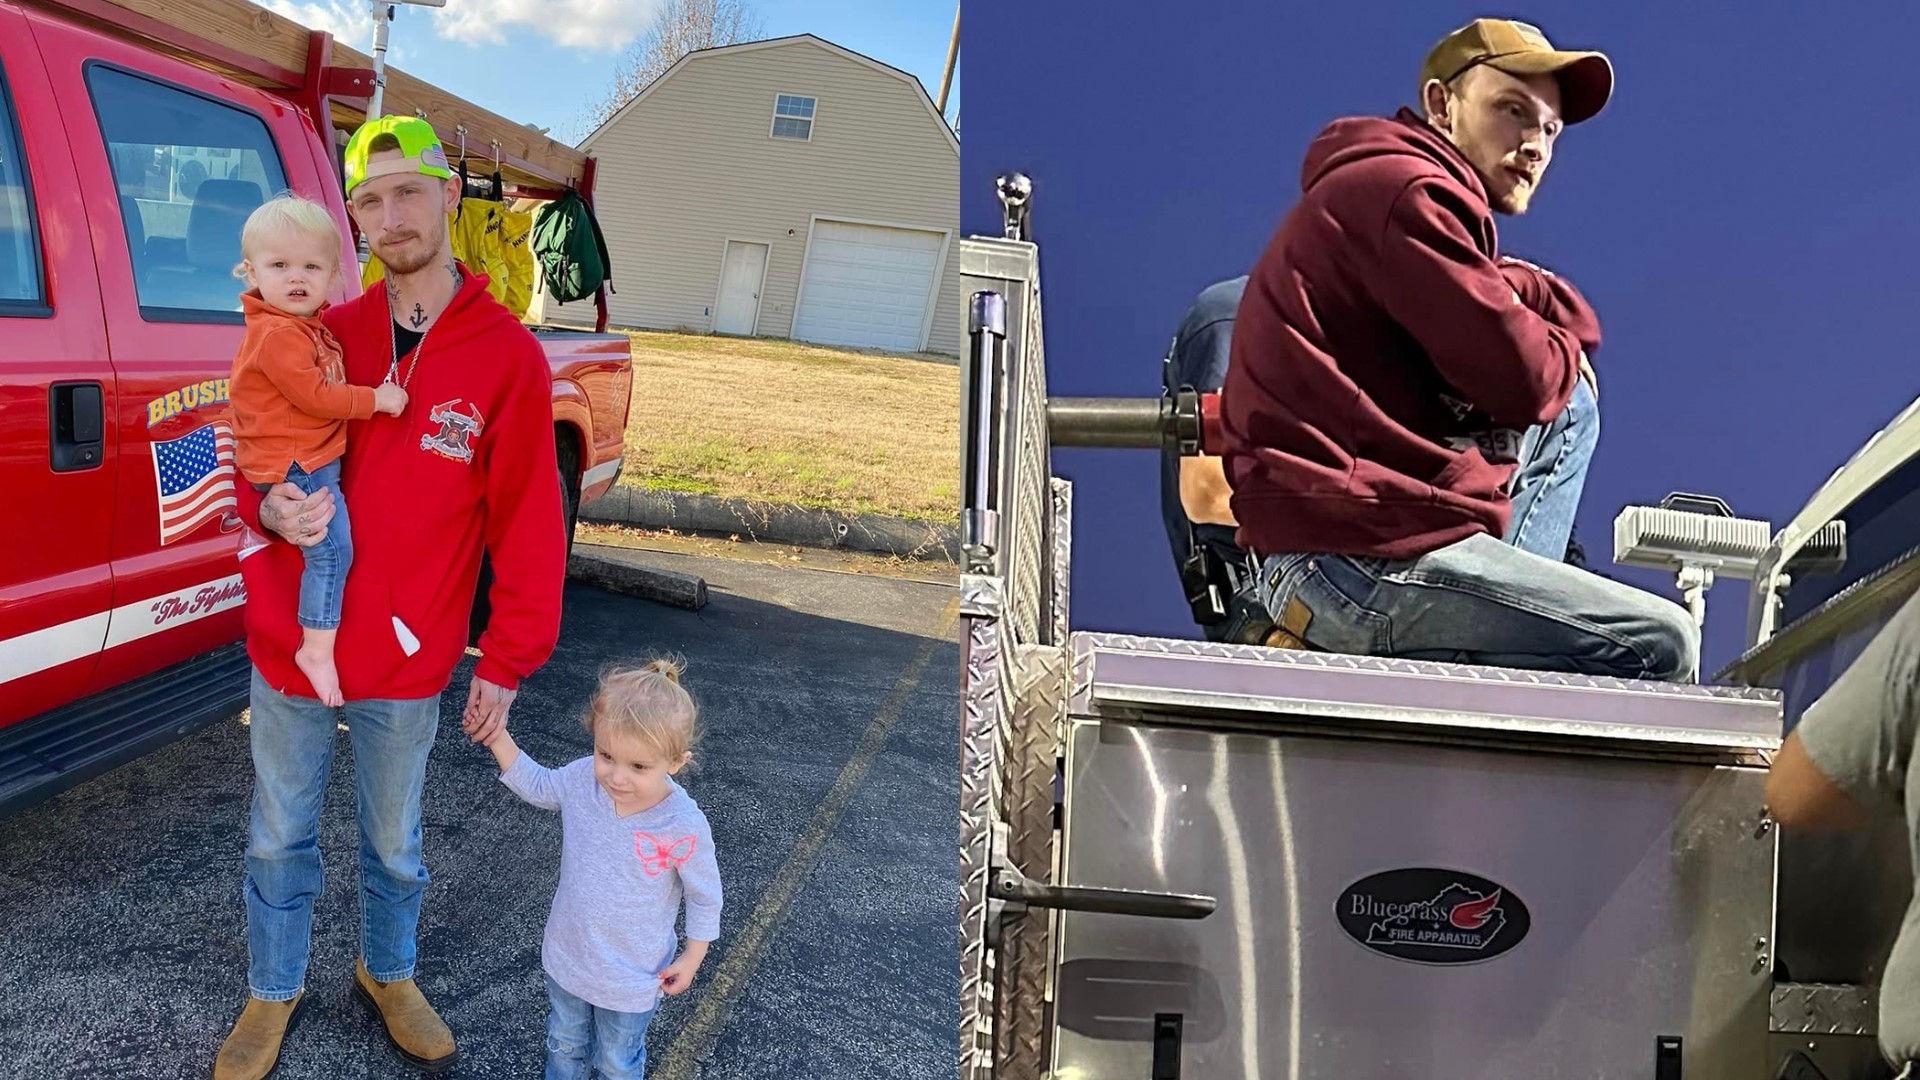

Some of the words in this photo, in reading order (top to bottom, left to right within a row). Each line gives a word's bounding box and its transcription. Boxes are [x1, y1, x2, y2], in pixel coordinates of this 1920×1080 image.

[146, 379, 231, 429] BRUSH
[1351, 894, 1448, 925] Bluegrass
[1390, 929, 1415, 941] FIRE
[1416, 931, 1482, 946] APPARATUS
